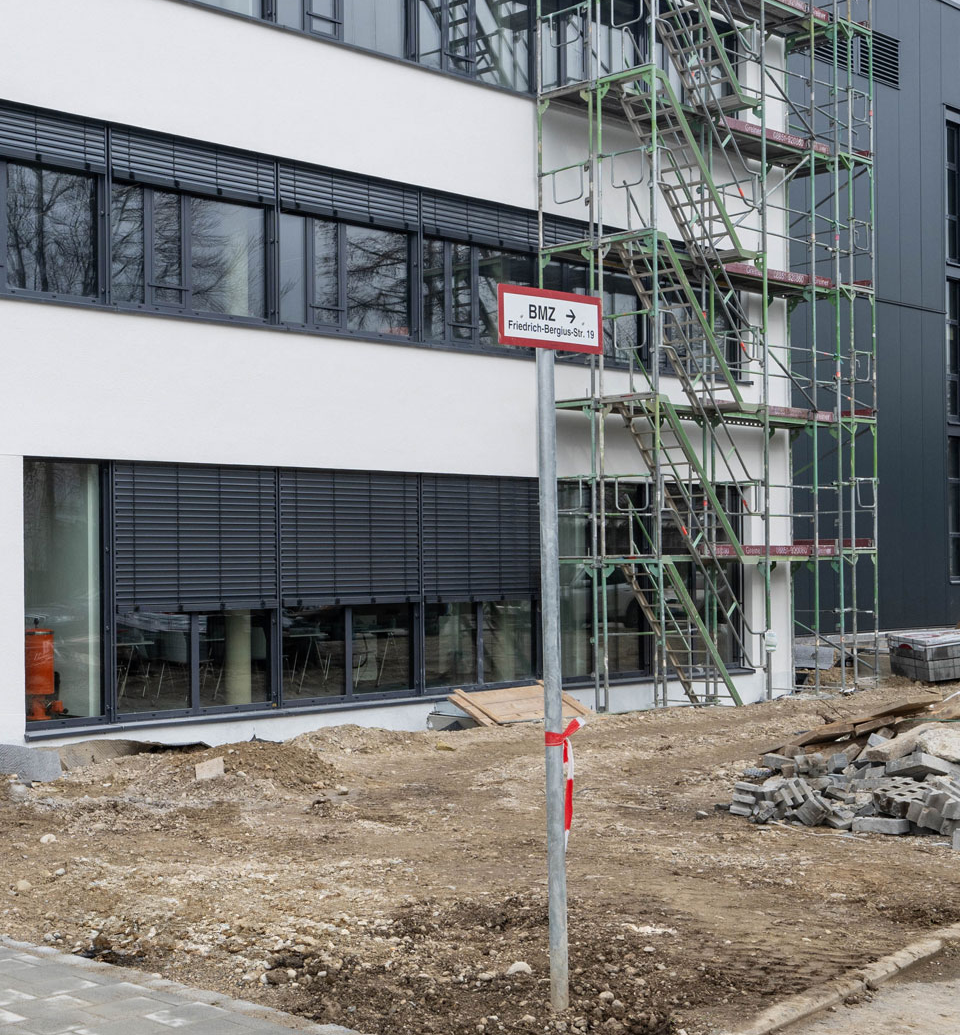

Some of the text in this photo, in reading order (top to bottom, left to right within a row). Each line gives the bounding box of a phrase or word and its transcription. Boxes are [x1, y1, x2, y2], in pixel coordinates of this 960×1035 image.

[529, 304, 556, 322] BMZ
[508, 320, 595, 339] Friedrich-Bergius-Str. 19
